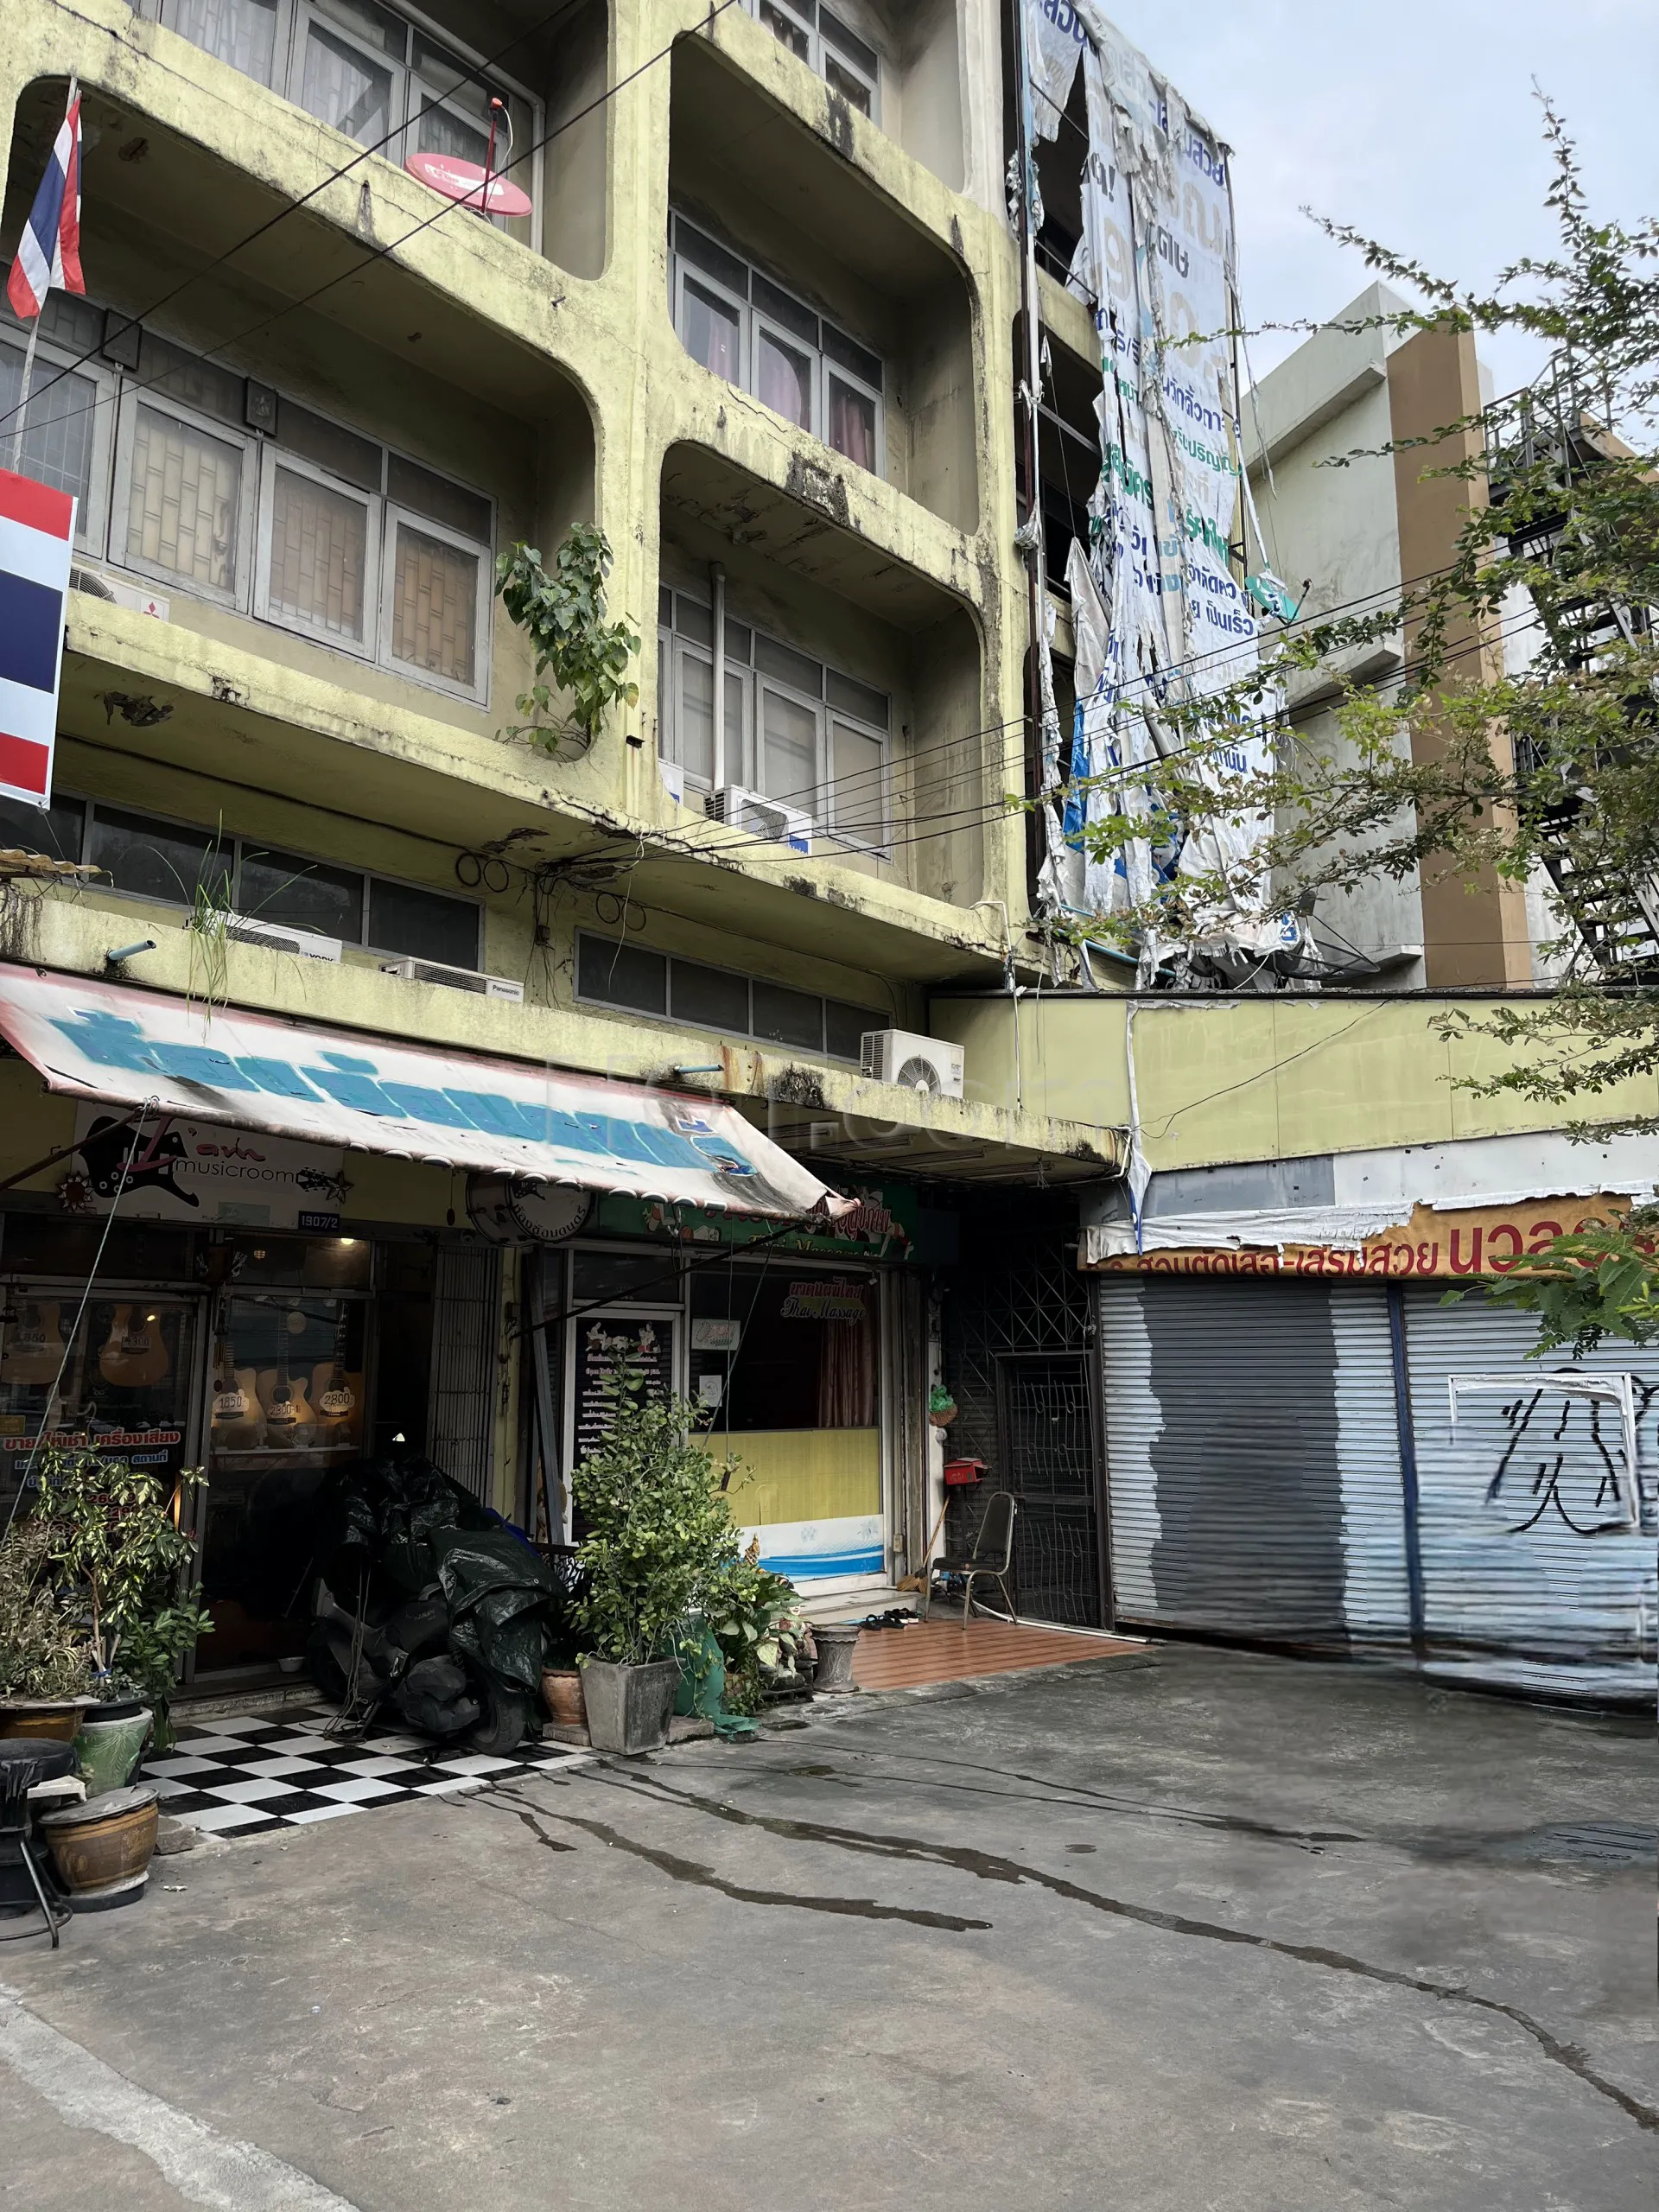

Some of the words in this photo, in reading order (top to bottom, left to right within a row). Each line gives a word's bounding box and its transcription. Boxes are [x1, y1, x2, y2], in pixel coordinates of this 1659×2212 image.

[493, 985, 520, 995] Panasonic
[176, 1159, 295, 1184] musicroom
[301, 1214, 339, 1229] 1907/2
[780, 1296, 811, 1319] Thai
[812, 1298, 867, 1326] Massage
[93, 1427, 181, 1447] เครื่องเสียง
[131, 1449, 168, 1465] สถานที่
